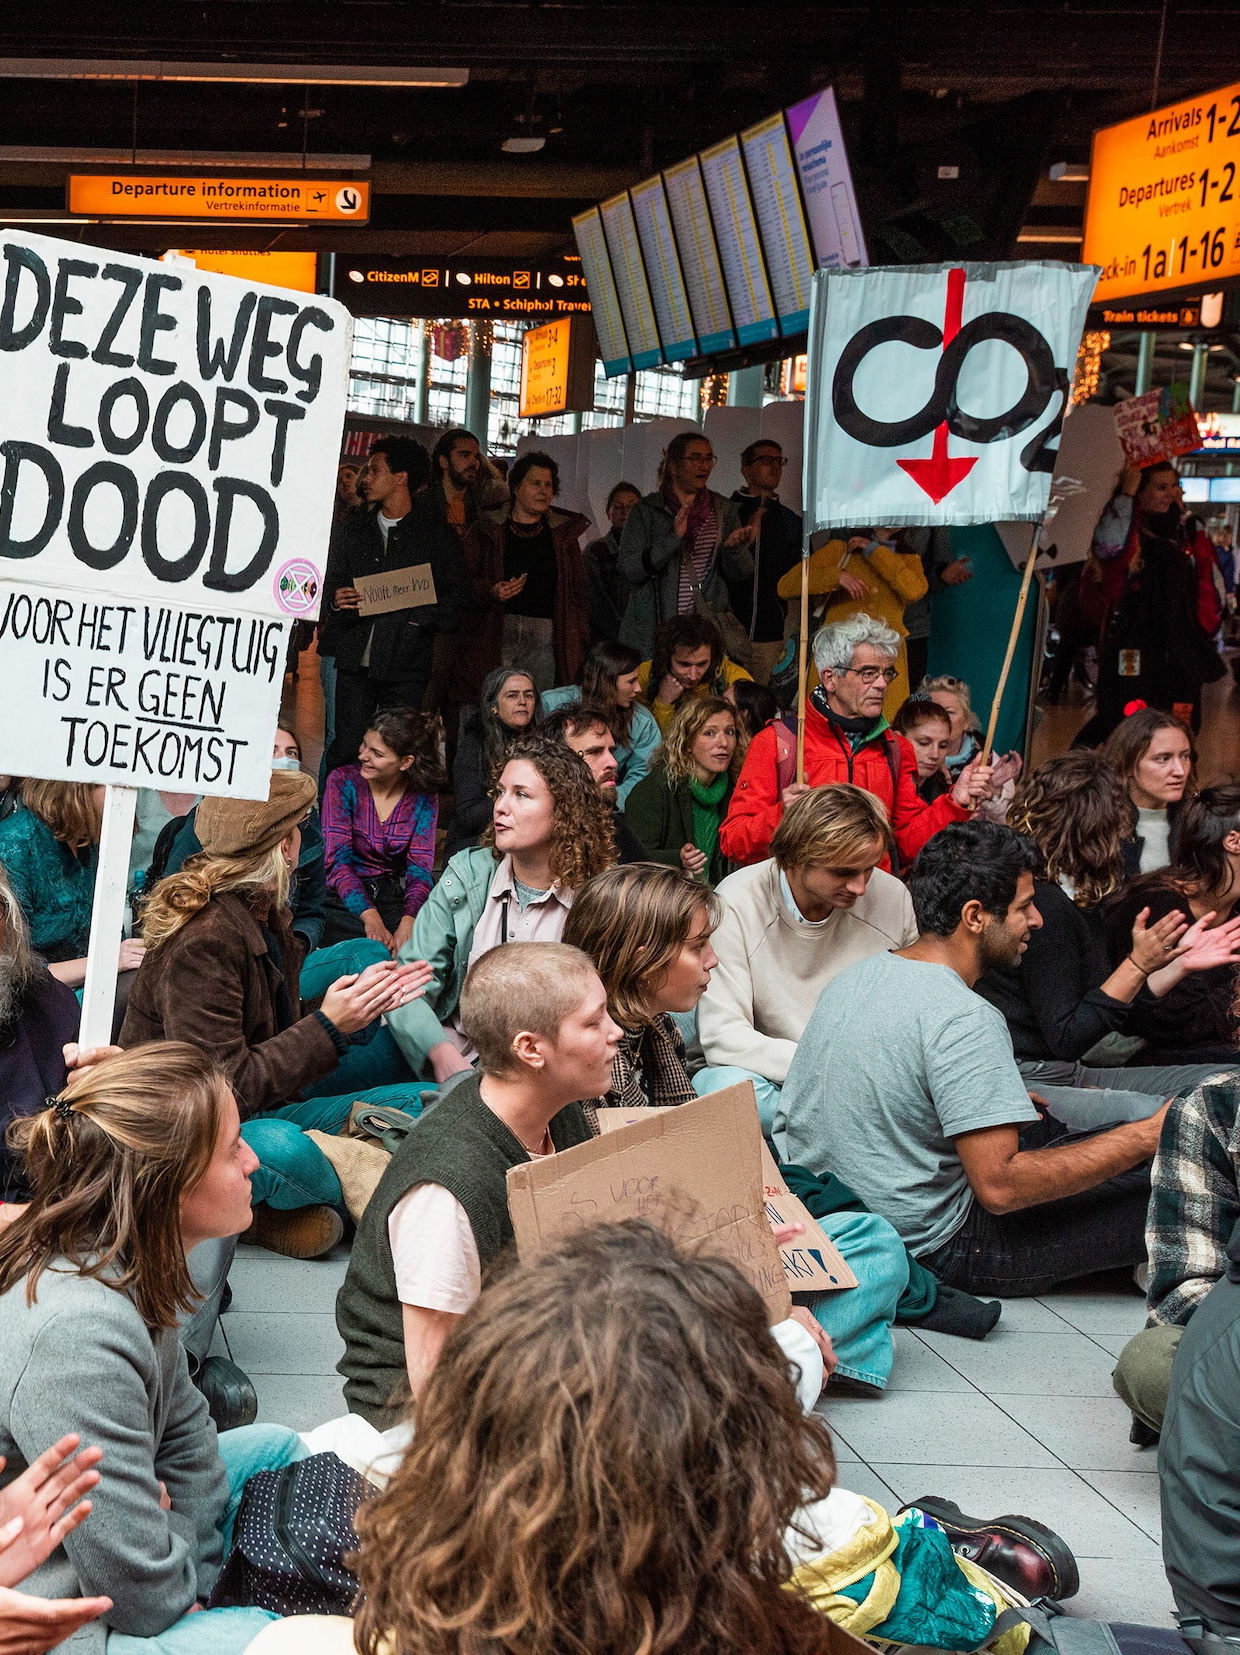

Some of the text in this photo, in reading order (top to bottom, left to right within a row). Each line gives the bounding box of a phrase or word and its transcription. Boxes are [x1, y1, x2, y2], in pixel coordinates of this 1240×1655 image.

[1146, 107, 1203, 141] Arrivals
[1153, 134, 1200, 160] Aankomst
[111, 181, 301, 199] Departure information
[1118, 161, 1236, 209] Departures 1-2
[205, 200, 300, 212] Vertrekinformatie
[1158, 196, 1192, 218] Vertrek
[366, 271, 419, 283] CitizenM
[474, 273, 510, 285] Hilton
[1099, 256, 1137, 282] eck-in
[468, 298, 490, 309] STA
[503, 298, 553, 312] Schiphol
[1103, 309, 1178, 323] Train tickets
[196, 285, 335, 403] WEG
[47, 361, 306, 488] LOOPT
[362, 585, 392, 604] Nooit
[412, 578, 430, 592] VVD
[77, 602, 136, 654] HET
[143, 605, 283, 683] VLIEGTUIG
[42, 658, 226, 725] IS ER GEEN
[60, 716, 249, 785] TOEKOMST
